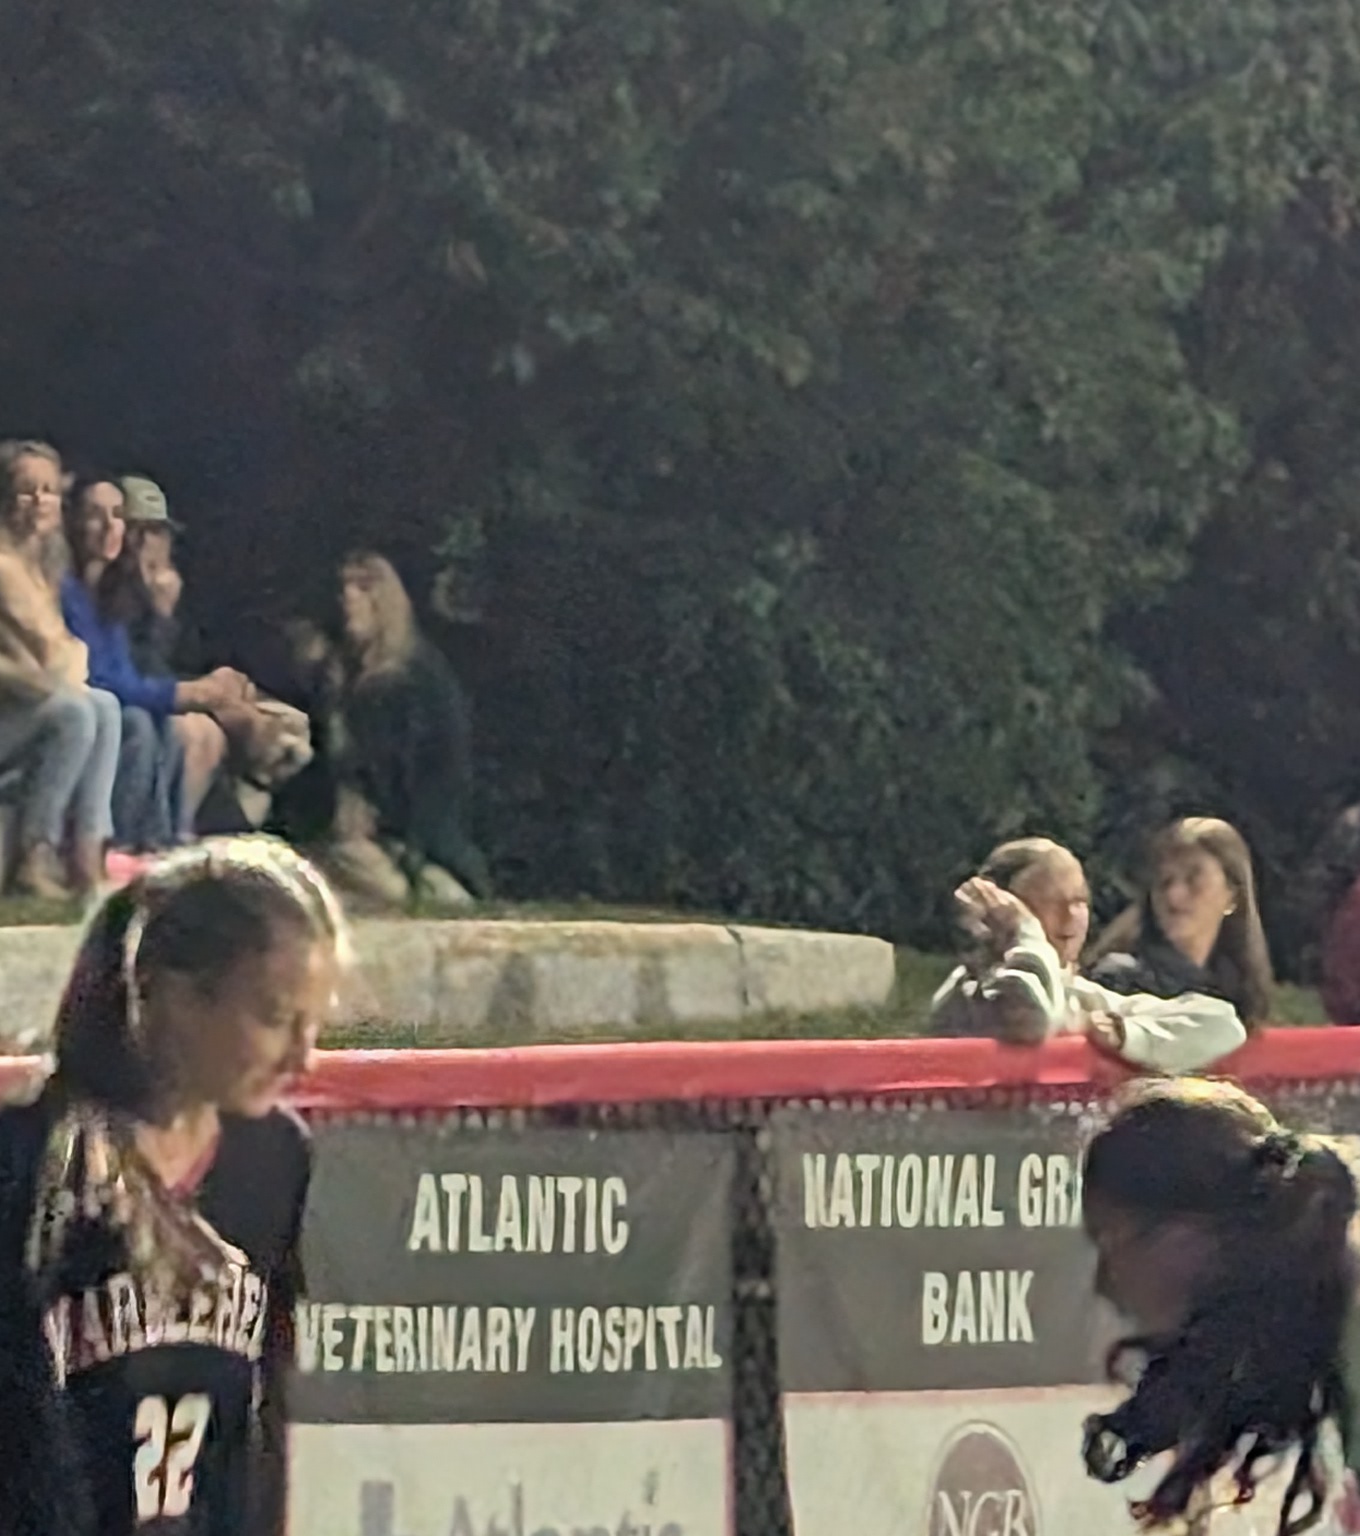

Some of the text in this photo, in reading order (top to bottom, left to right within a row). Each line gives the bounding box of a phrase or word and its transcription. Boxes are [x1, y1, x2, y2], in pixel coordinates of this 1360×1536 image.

[407, 1172, 630, 1254] ATLANTIC
[802, 1153, 1004, 1229] NATIONAL
[294, 1302, 723, 1374] VETERINARY HOSPITAL
[922, 1270, 1035, 1345] BANK
[133, 1394, 211, 1522] 22
